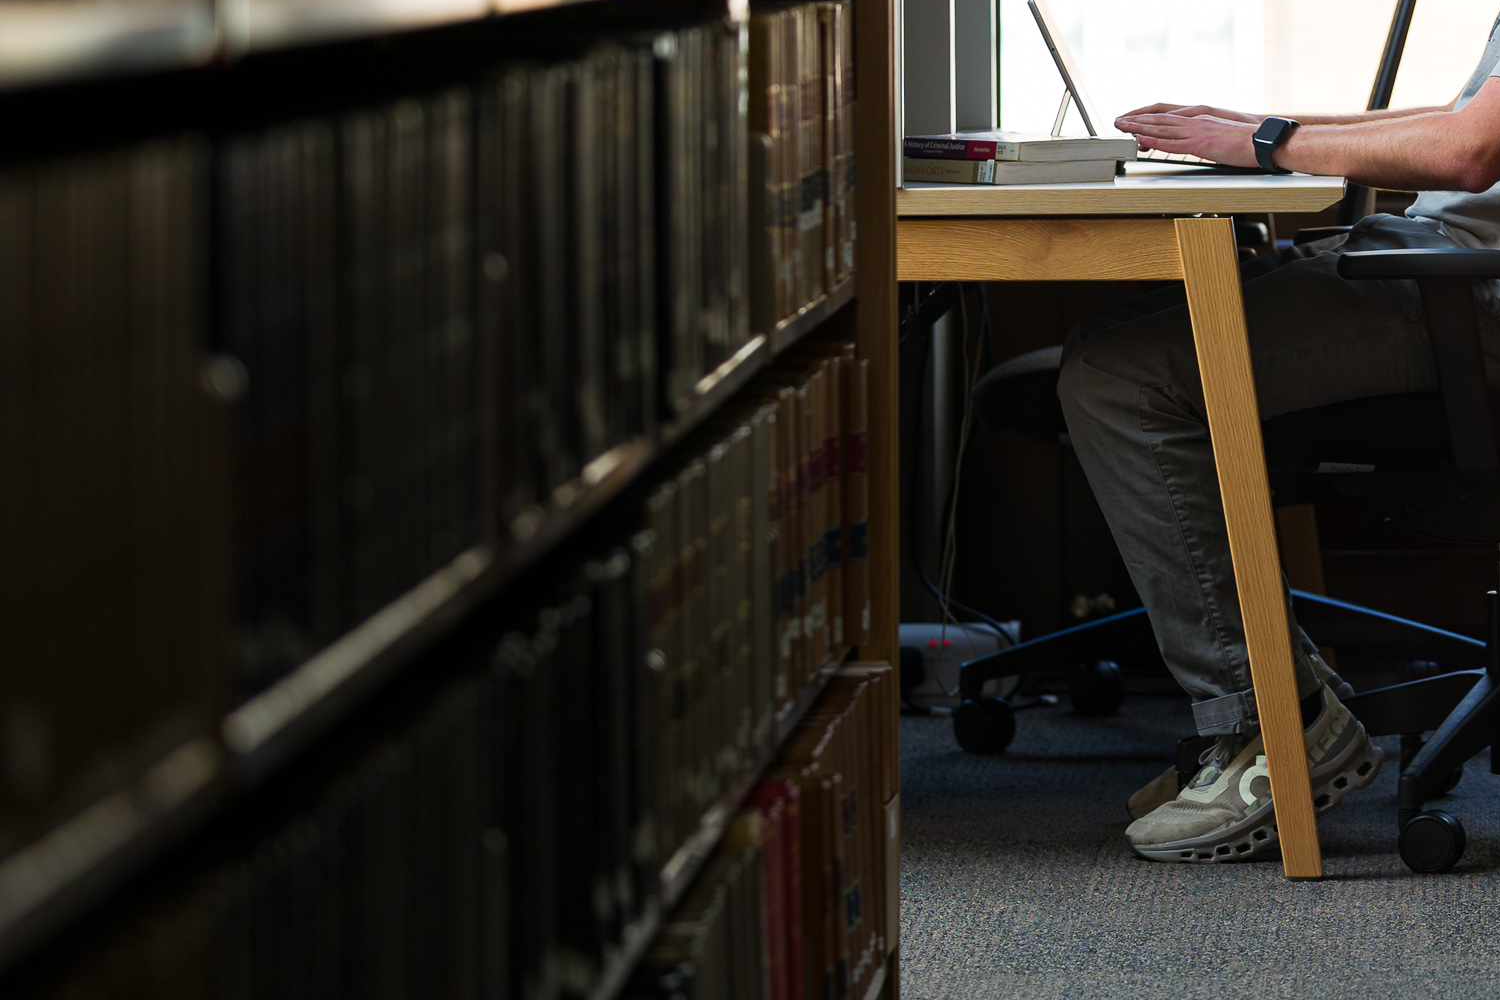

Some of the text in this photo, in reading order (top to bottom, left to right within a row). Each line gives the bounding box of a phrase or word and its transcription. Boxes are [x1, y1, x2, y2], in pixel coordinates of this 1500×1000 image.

[907, 141, 924, 150] History
[924, 141, 930, 149] of
[930, 141, 949, 149] Criminal
[949, 142, 966, 151] Justice
[904, 165, 925, 175] MAGNA
[926, 166, 944, 176] CARTA
